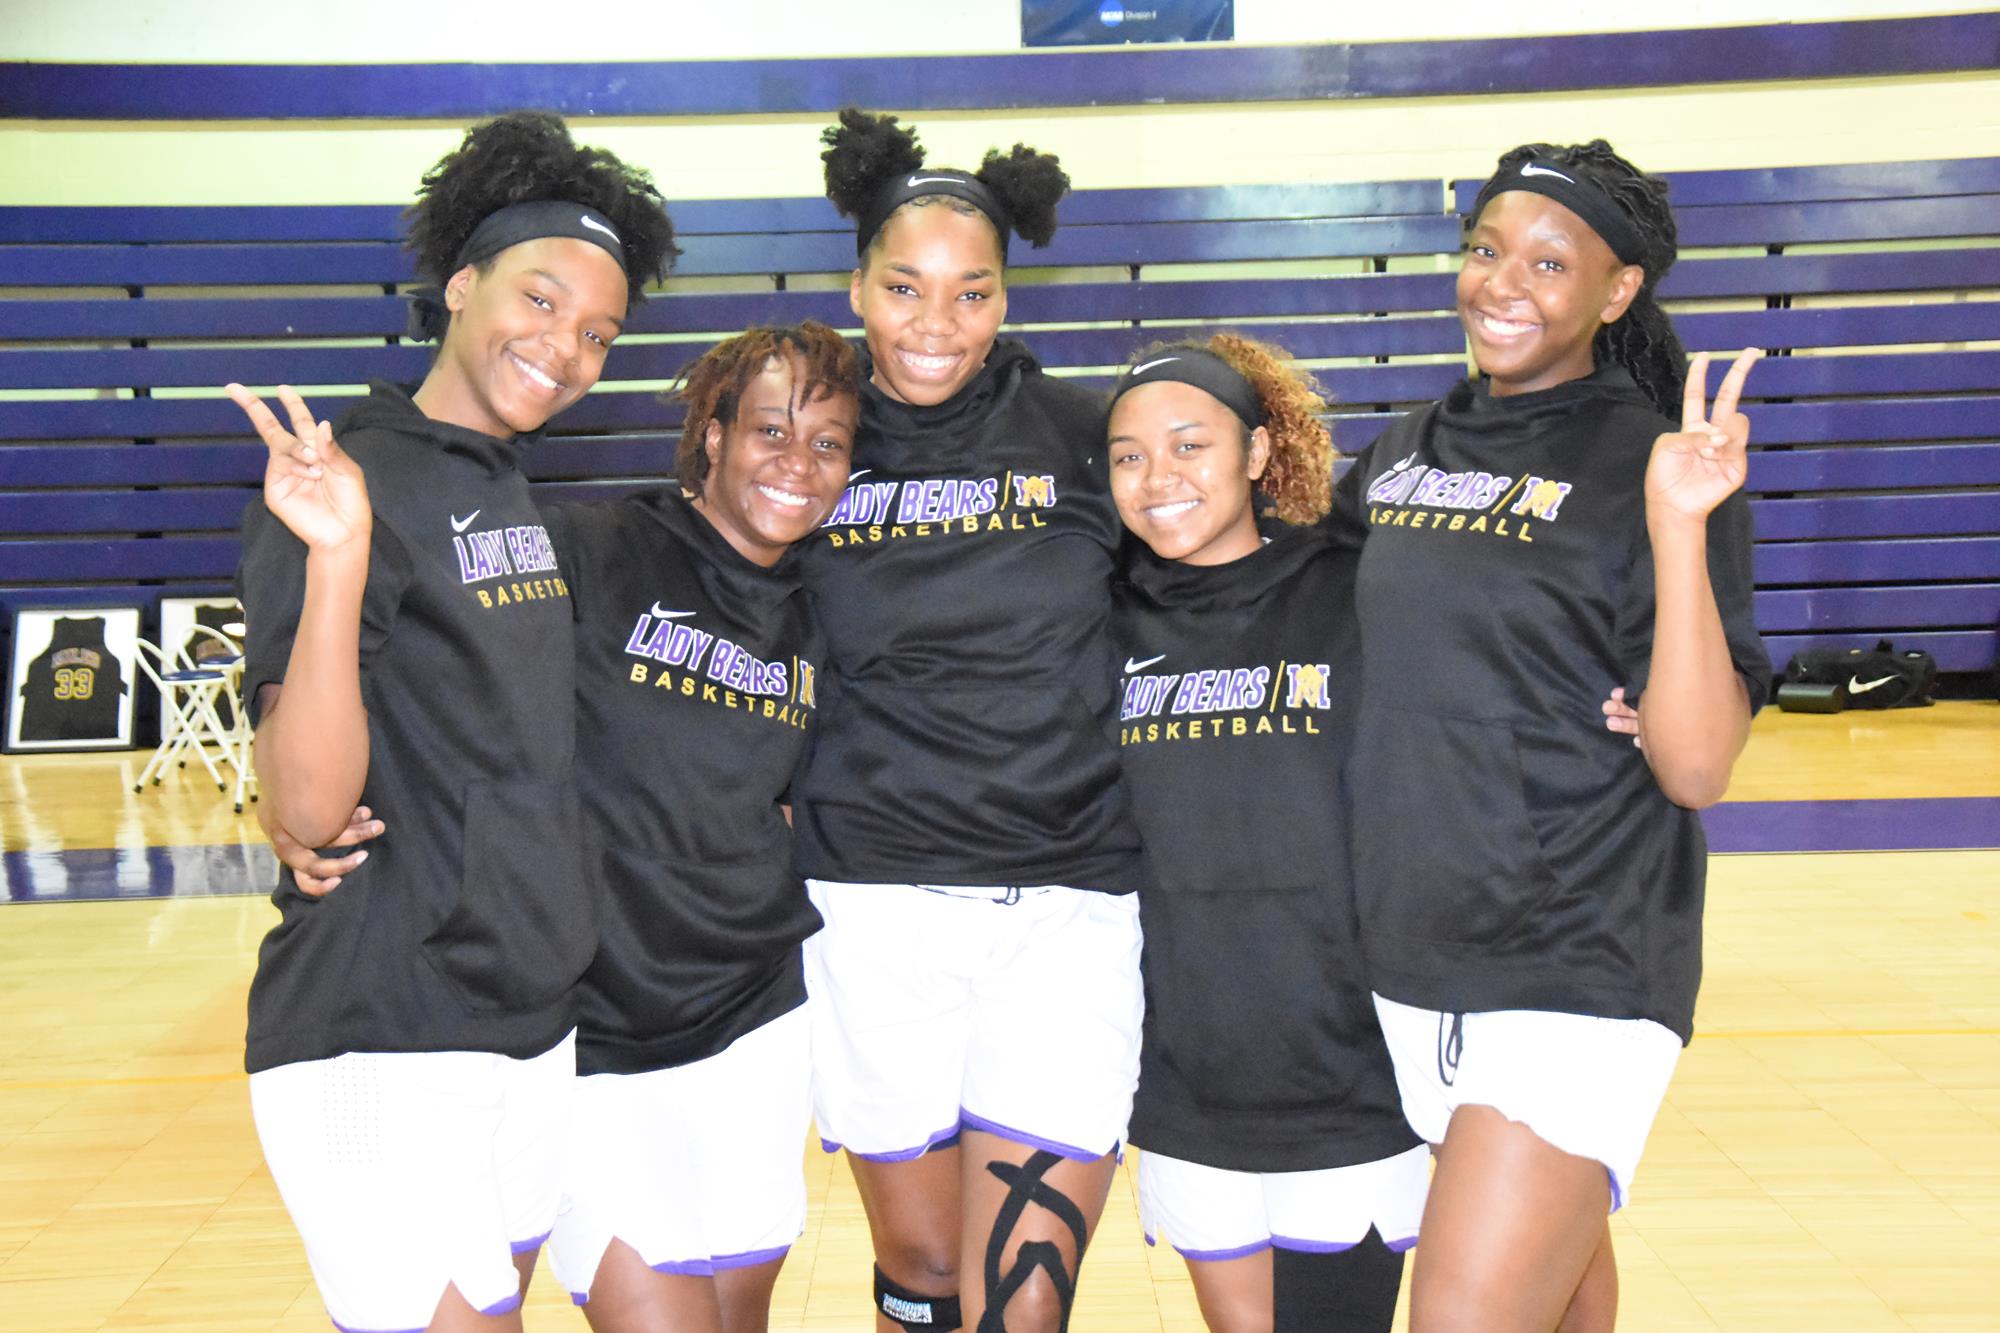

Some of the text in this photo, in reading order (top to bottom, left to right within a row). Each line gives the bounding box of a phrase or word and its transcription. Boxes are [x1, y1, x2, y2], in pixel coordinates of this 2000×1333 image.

[821, 482, 898, 528] ADY
[897, 477, 998, 524] BEARS
[1408, 468, 1512, 509] BEARS
[828, 512, 1047, 547] BASKETBALL
[453, 526, 557, 584] LADY BEARS
[624, 613, 714, 671] LADY
[706, 638, 788, 696] BEARS
[54, 668, 95, 700] 33
[629, 663, 807, 730] BASKETBALL
[1171, 666, 1271, 715] BEARS
[1121, 714, 1320, 746] BASKETBALL
